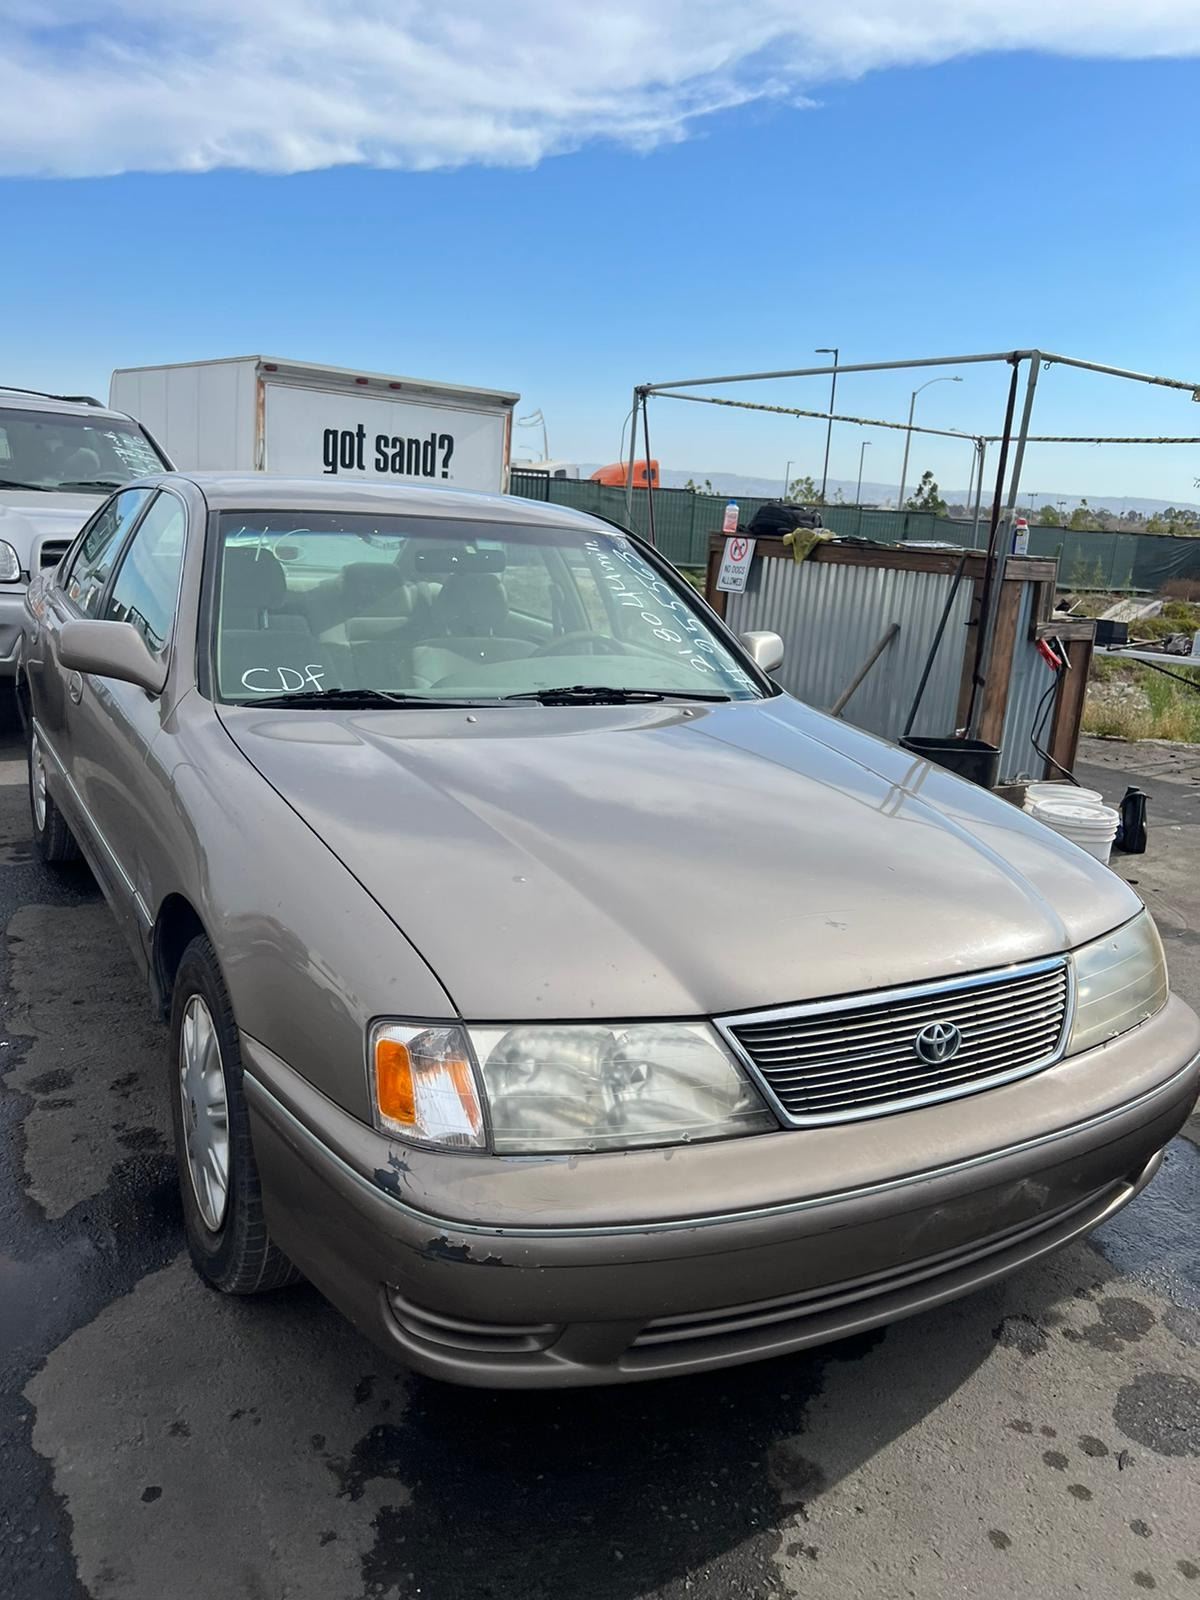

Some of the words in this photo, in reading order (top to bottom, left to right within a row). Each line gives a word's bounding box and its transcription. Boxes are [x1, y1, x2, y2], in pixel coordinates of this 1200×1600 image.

[323, 424, 366, 475] got
[374, 432, 454, 479] sand?
[732, 565, 745, 575] DOGS
[721, 577, 743, 587] ALLOWED
